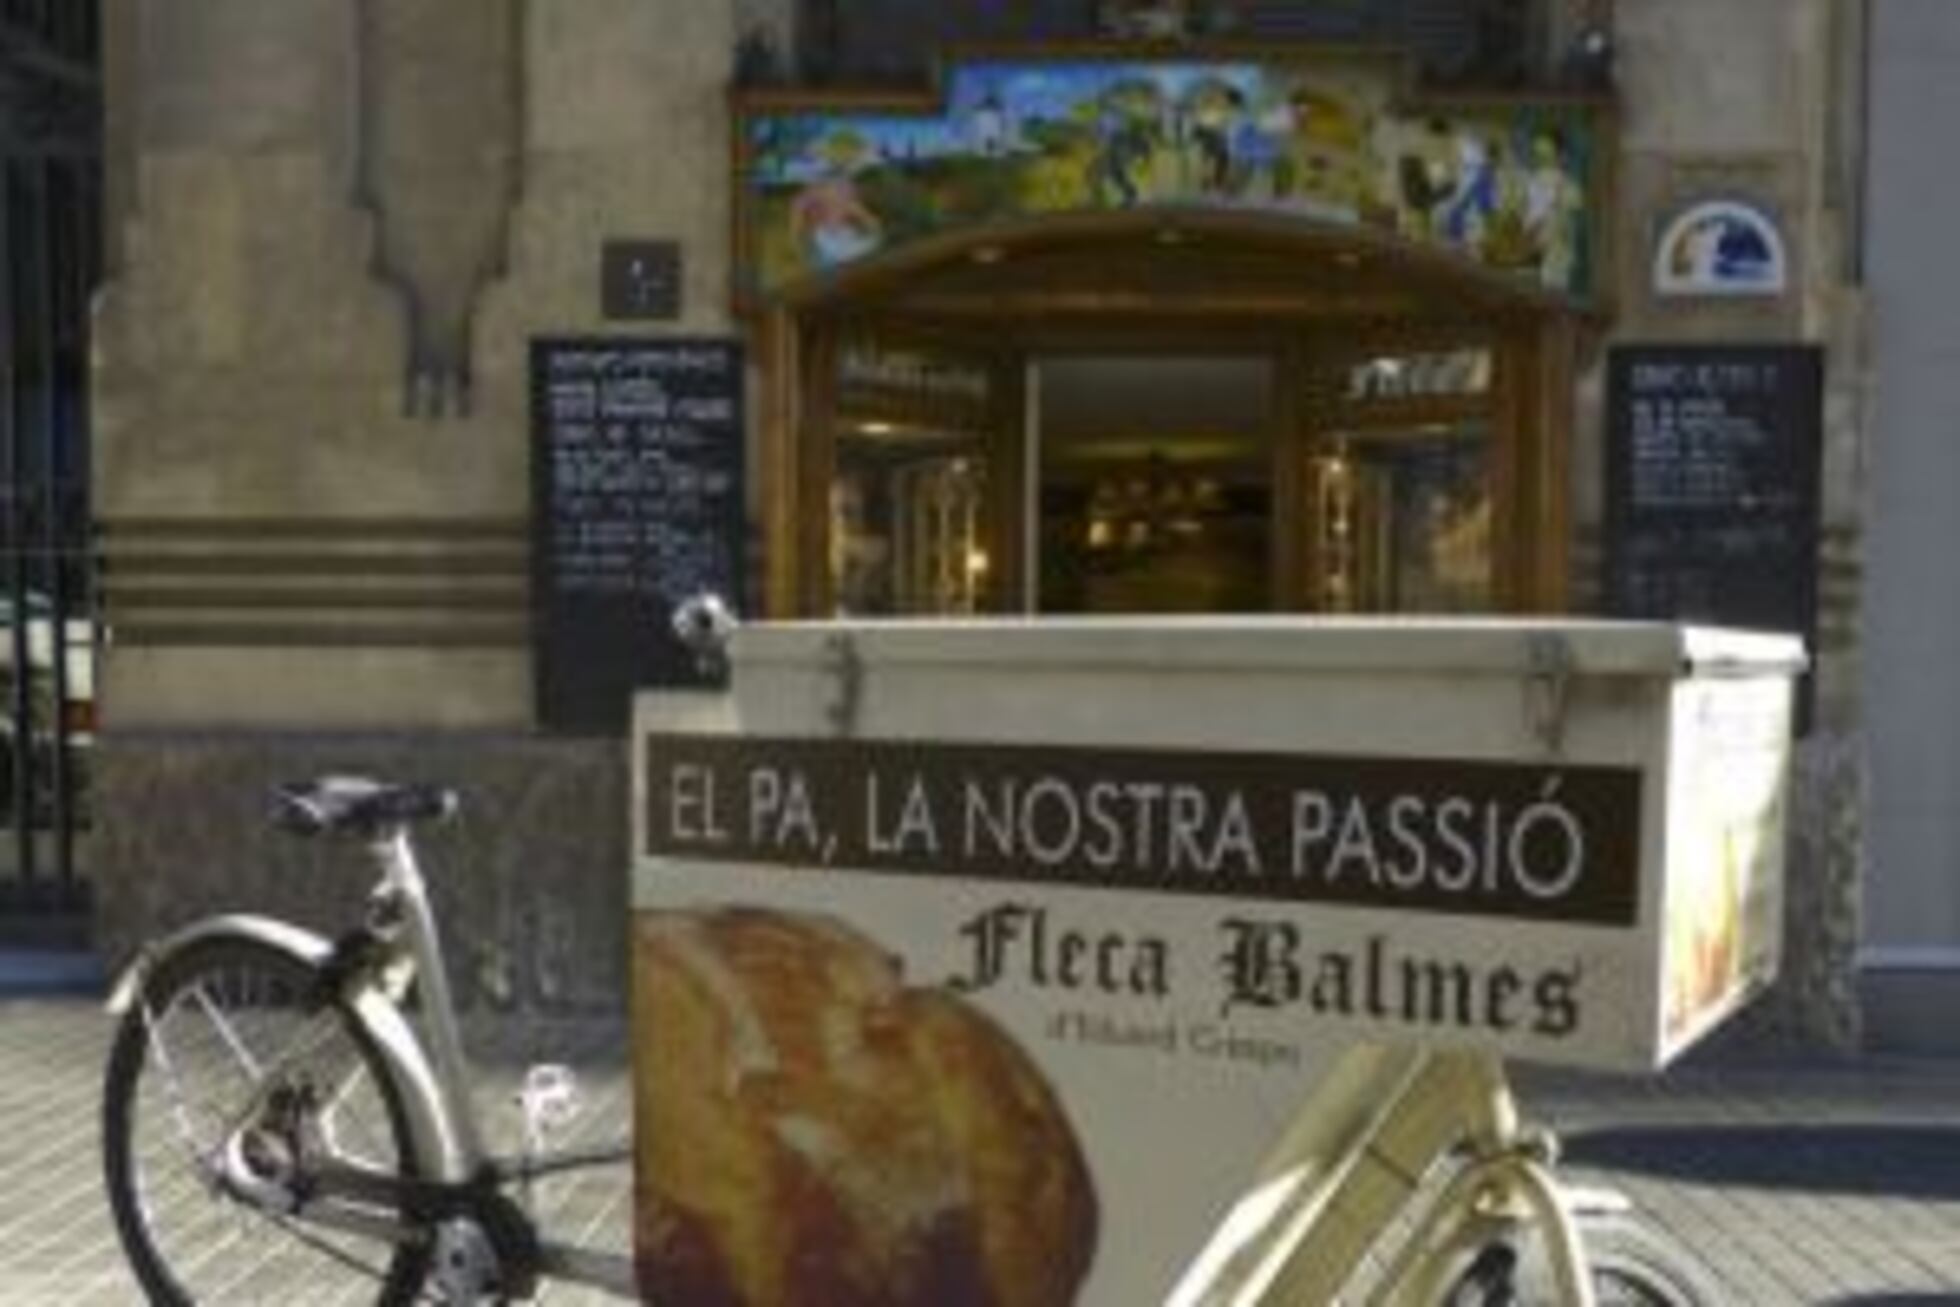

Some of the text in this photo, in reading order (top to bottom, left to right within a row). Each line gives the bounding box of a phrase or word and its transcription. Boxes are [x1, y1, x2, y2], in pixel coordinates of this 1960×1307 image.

[672, 764, 1584, 897] EL PA, LA NOSTRA PASSIÓ
[945, 902, 1582, 1037] Fleca Balmes
